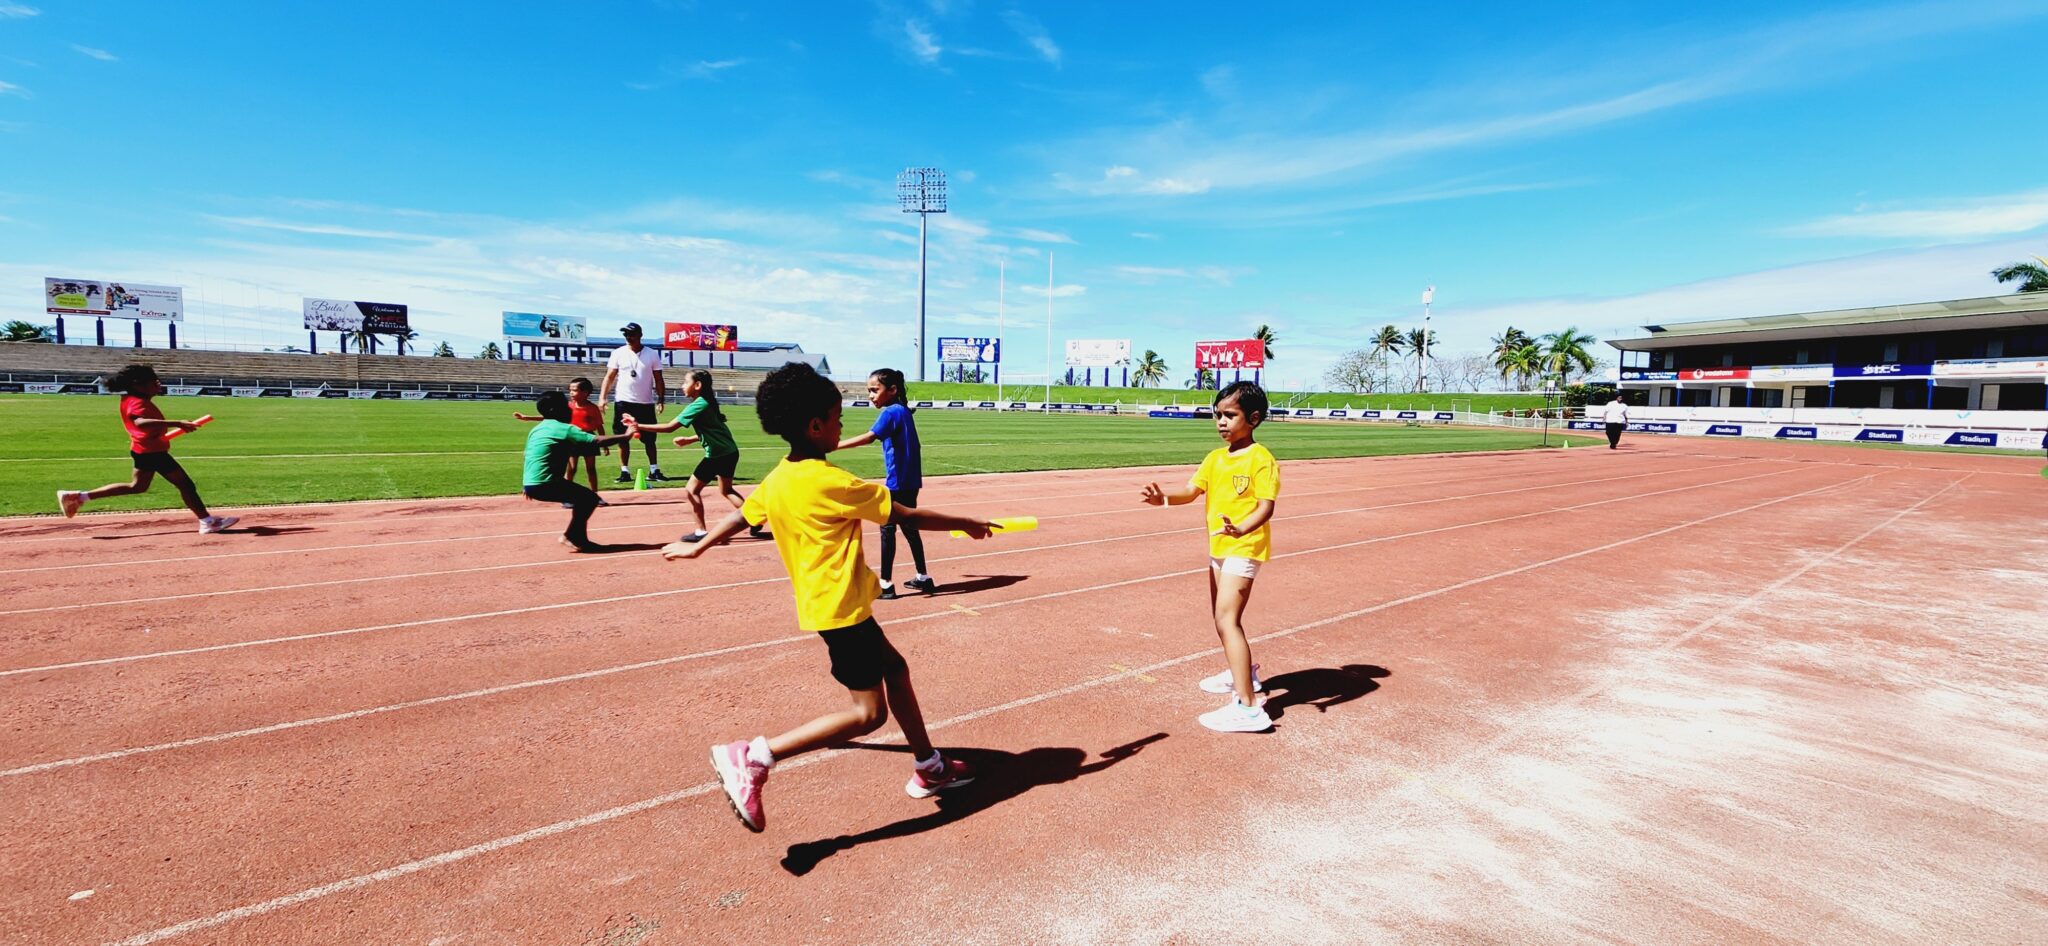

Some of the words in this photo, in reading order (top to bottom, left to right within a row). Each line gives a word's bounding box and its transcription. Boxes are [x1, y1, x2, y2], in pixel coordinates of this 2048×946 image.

[311, 300, 349, 313] Bula!
[1868, 431, 1897, 439] Stadium
[1959, 435, 1991, 444] Stadium
